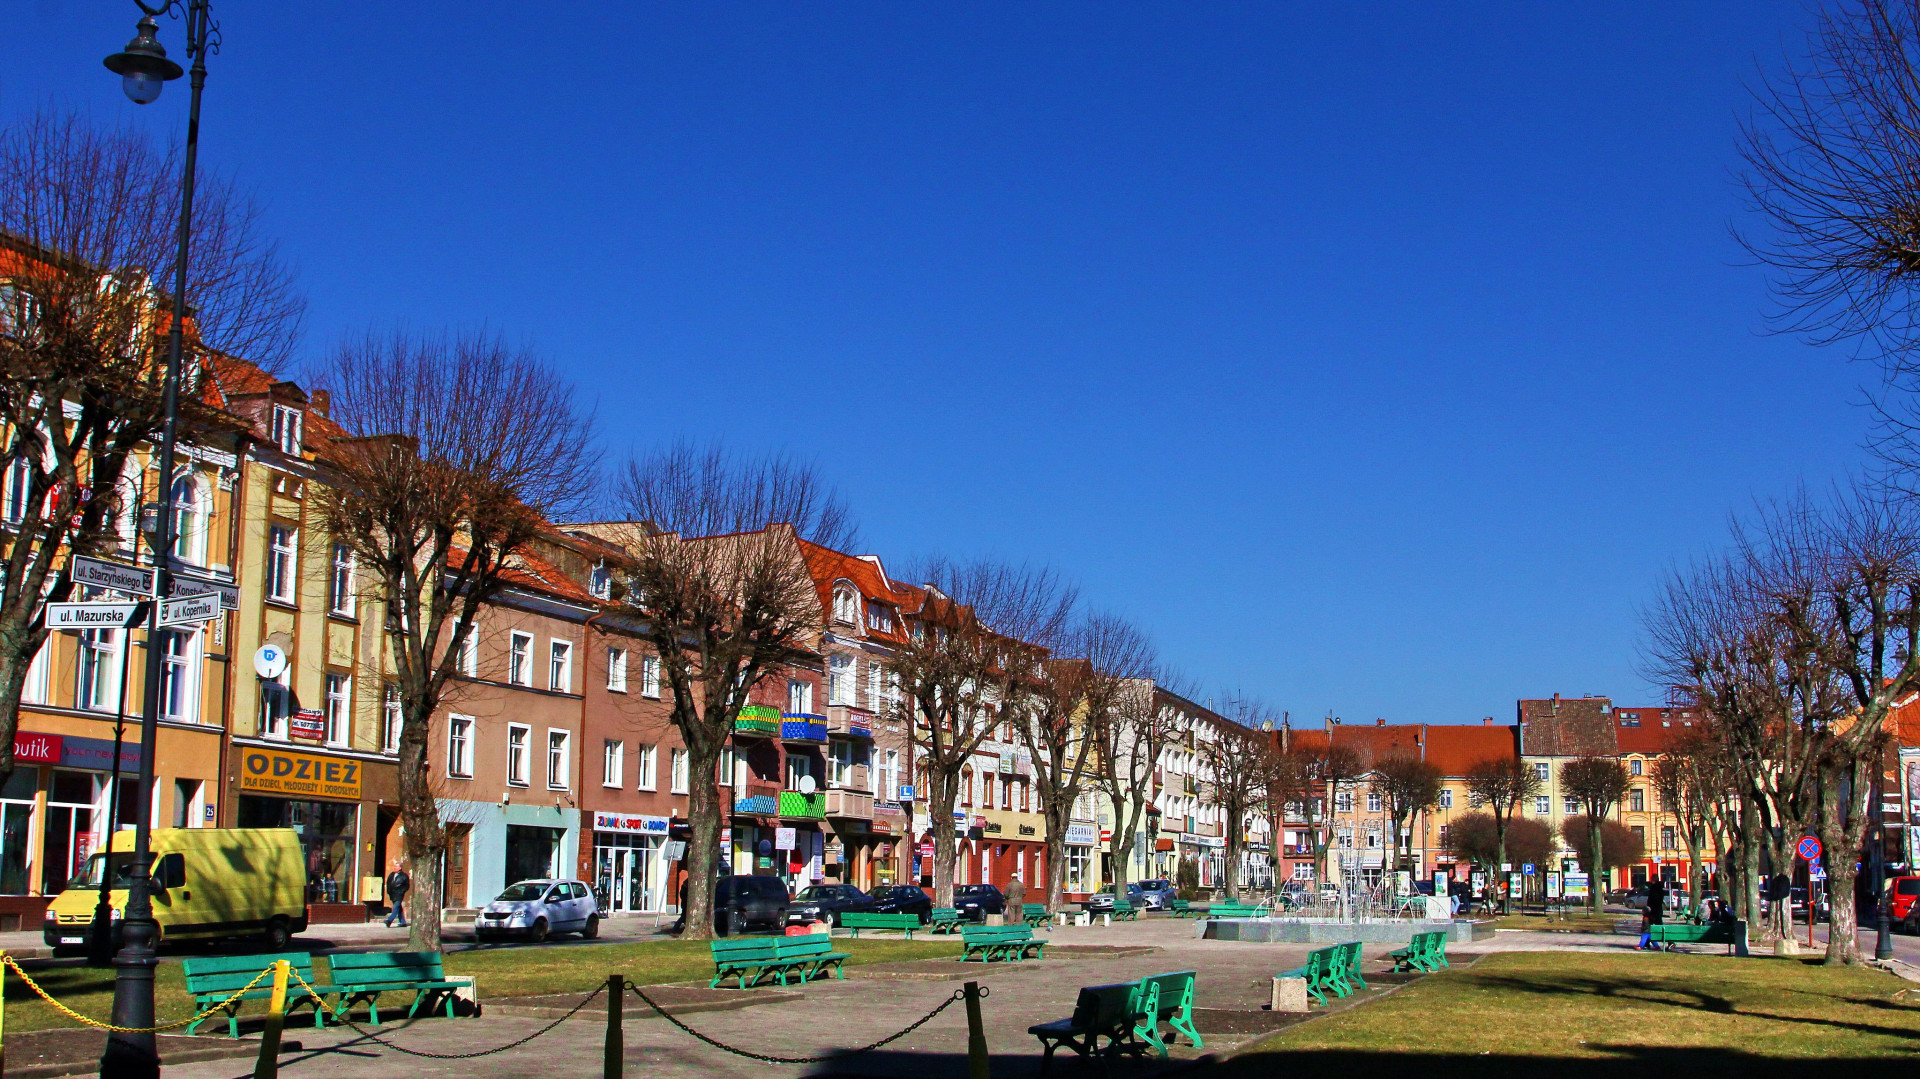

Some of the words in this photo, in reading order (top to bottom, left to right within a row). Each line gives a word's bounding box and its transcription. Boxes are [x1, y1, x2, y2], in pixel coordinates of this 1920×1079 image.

[78, 566, 87, 578] ul.
[89, 567, 141, 589] Starzyńskiego
[221, 592, 236, 607] Maja
[60, 610, 73, 622] ul.
[75, 609, 124, 622] Mazurska
[182, 603, 211, 618] Kopernika
[246, 753, 358, 785] ODZIEŻ
[244, 776, 258, 787] DLA
[259, 778, 282, 789] DZIECI,
[284, 780, 318, 793] MŁODZIEŻY
[324, 785, 359, 796] DOROSŁYCH
[1525, 865, 1532, 873] P
